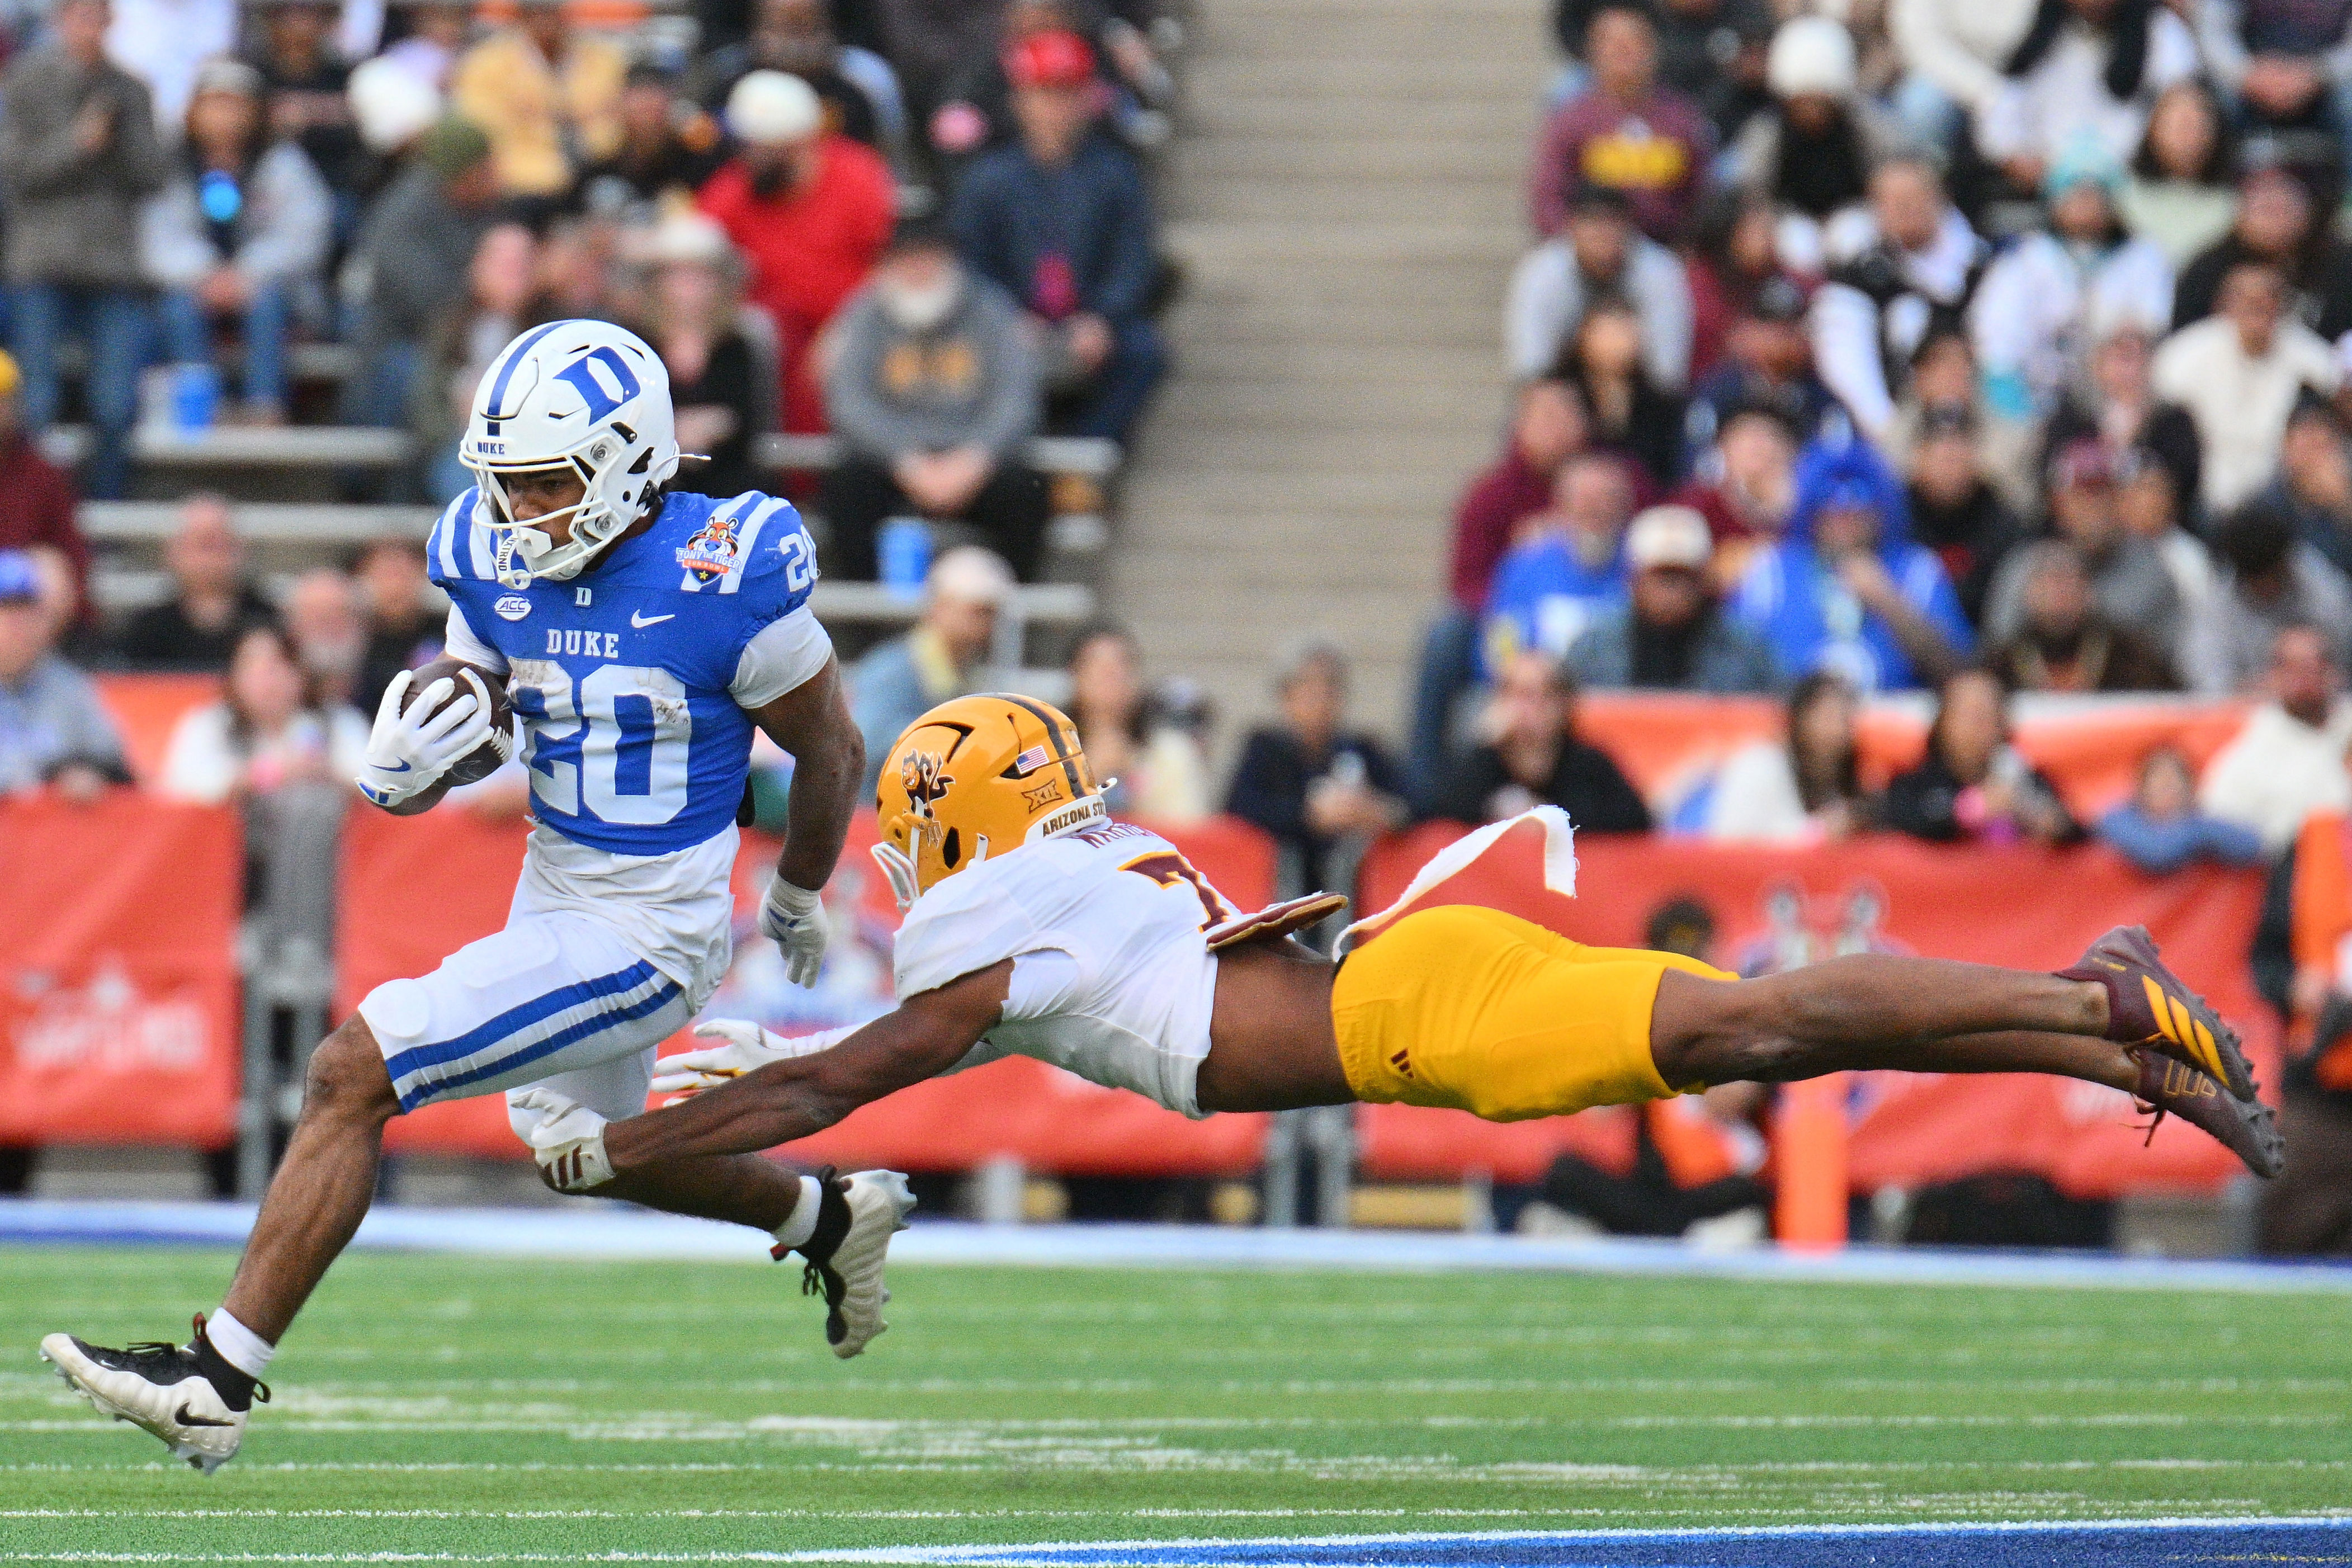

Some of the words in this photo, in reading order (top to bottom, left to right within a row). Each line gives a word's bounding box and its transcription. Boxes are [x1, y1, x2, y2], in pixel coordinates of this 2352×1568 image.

[553, 346, 641, 427] D
[477, 441, 506, 455] DUKE
[677, 549, 703, 560] TONY
[715, 554, 740, 569] TIGER
[703, 563, 725, 572] BOWL
[498, 600, 527, 610] ACC
[575, 587, 592, 607] D
[546, 628, 619, 659] DUKE
[507, 656, 692, 825] 20
[1042, 804, 1092, 838] ARIZONA
